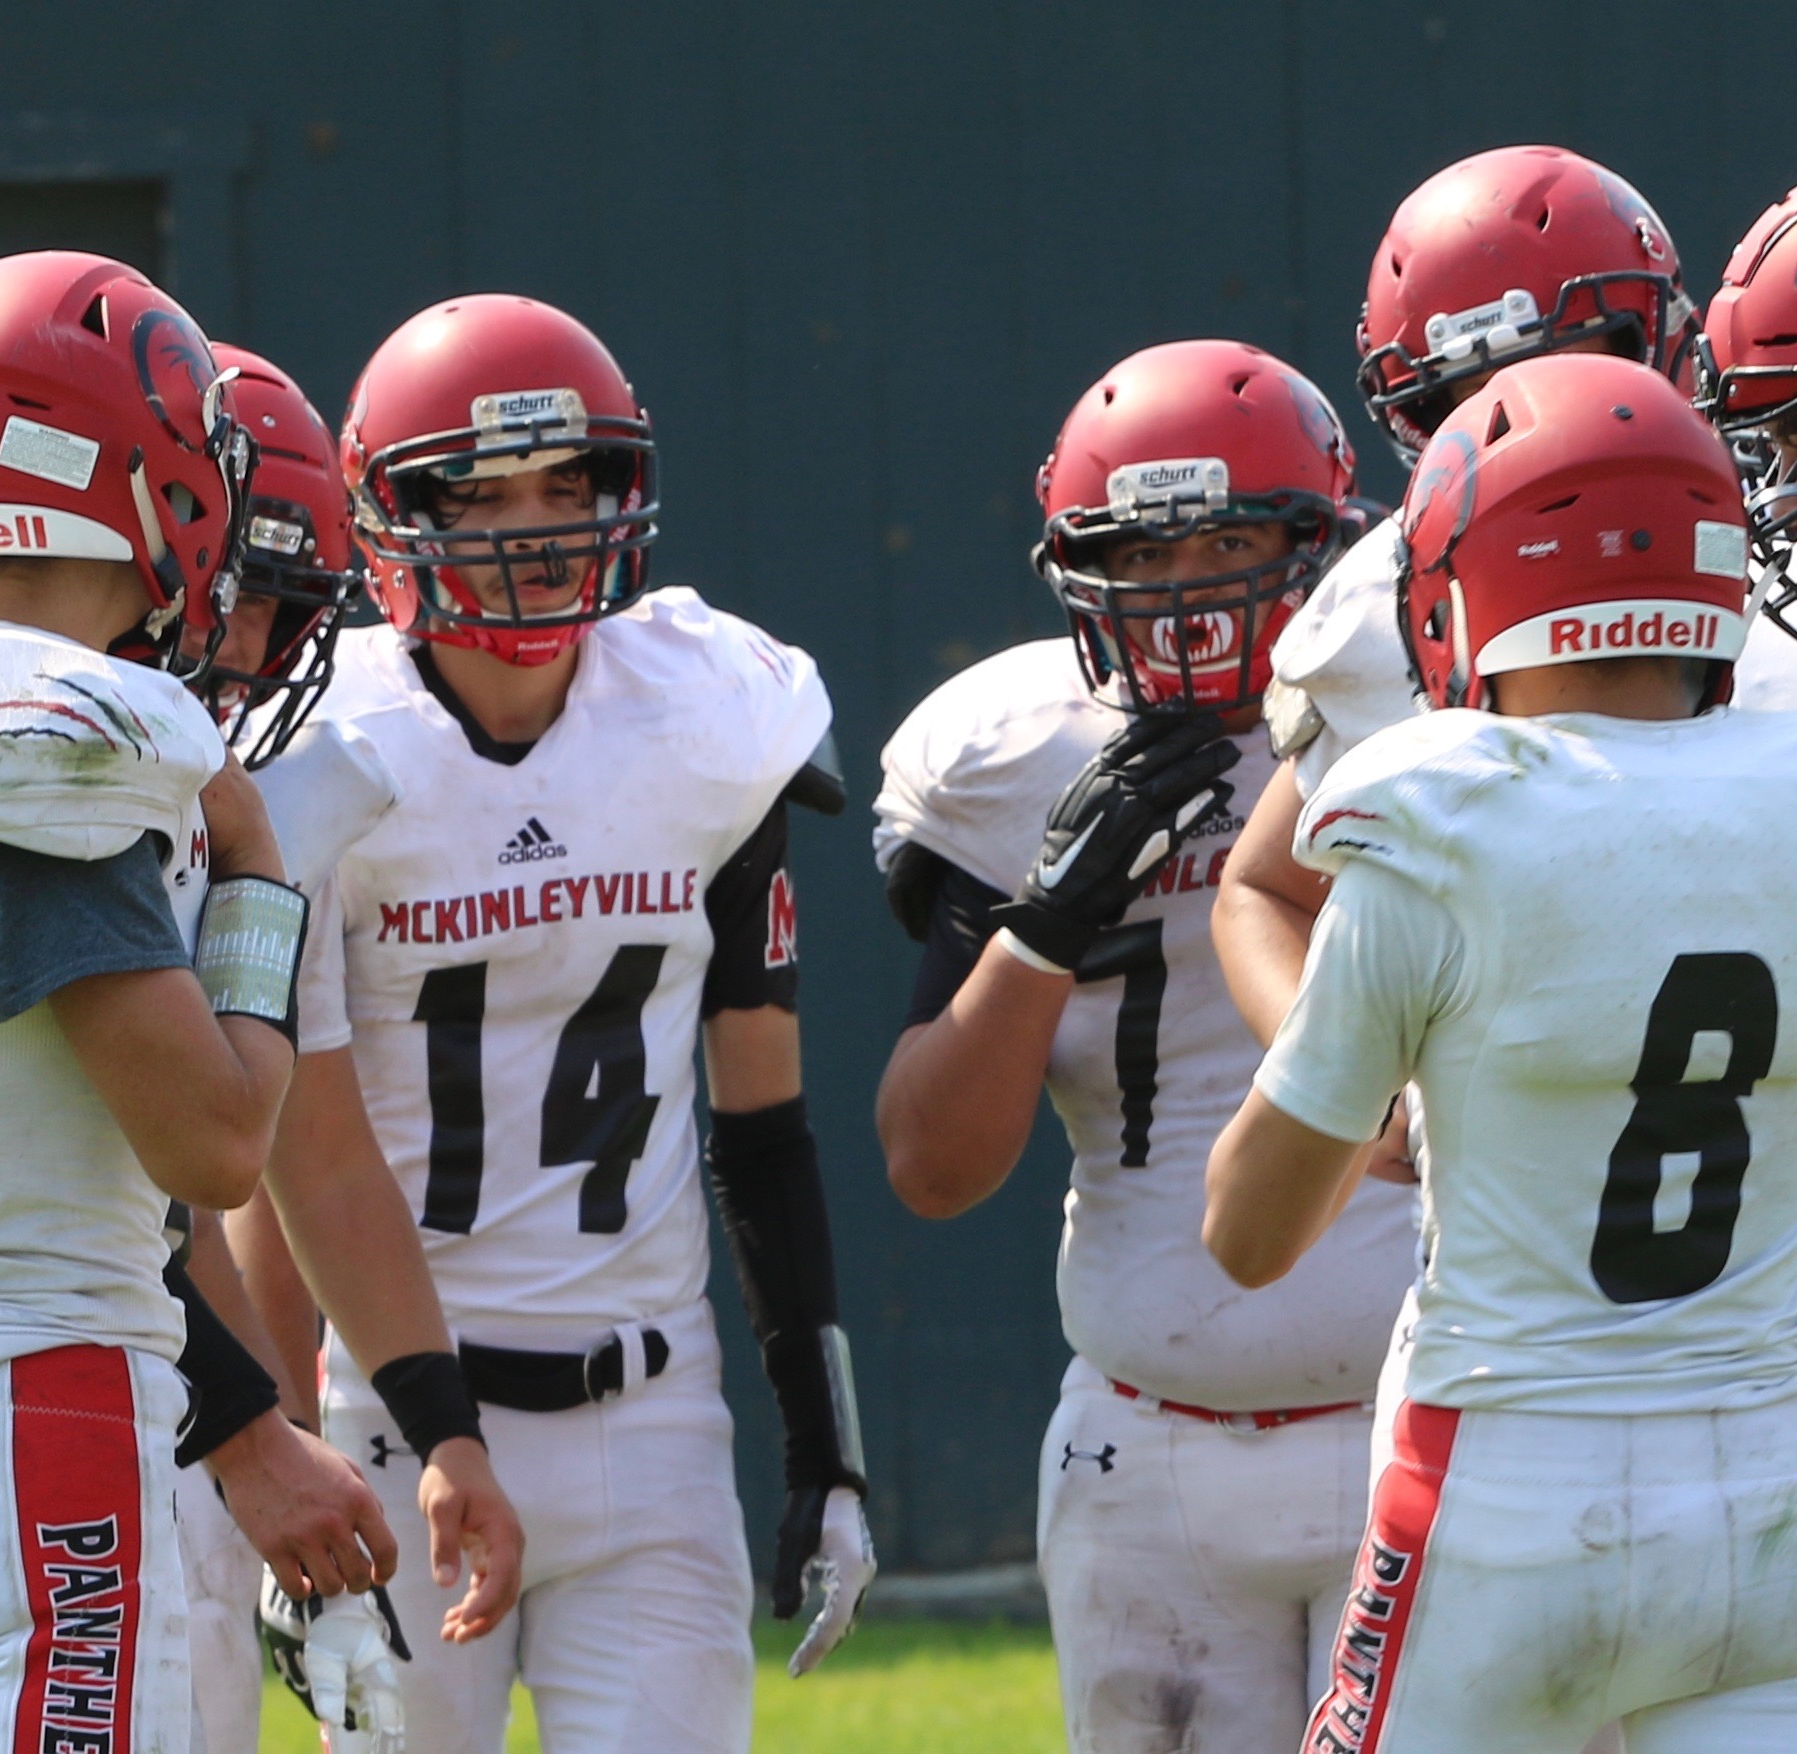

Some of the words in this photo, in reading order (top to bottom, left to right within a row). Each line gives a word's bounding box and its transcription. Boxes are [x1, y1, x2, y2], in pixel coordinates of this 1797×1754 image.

[499, 395, 554, 412] schutt
[1139, 464, 1197, 484] schutt
[1549, 611, 1719, 656] Riddell
[498, 840, 568, 866] adidas
[378, 868, 698, 944] MCKINLEYVILLE
[411, 943, 670, 1237] 14
[1589, 951, 1780, 1304] 8
